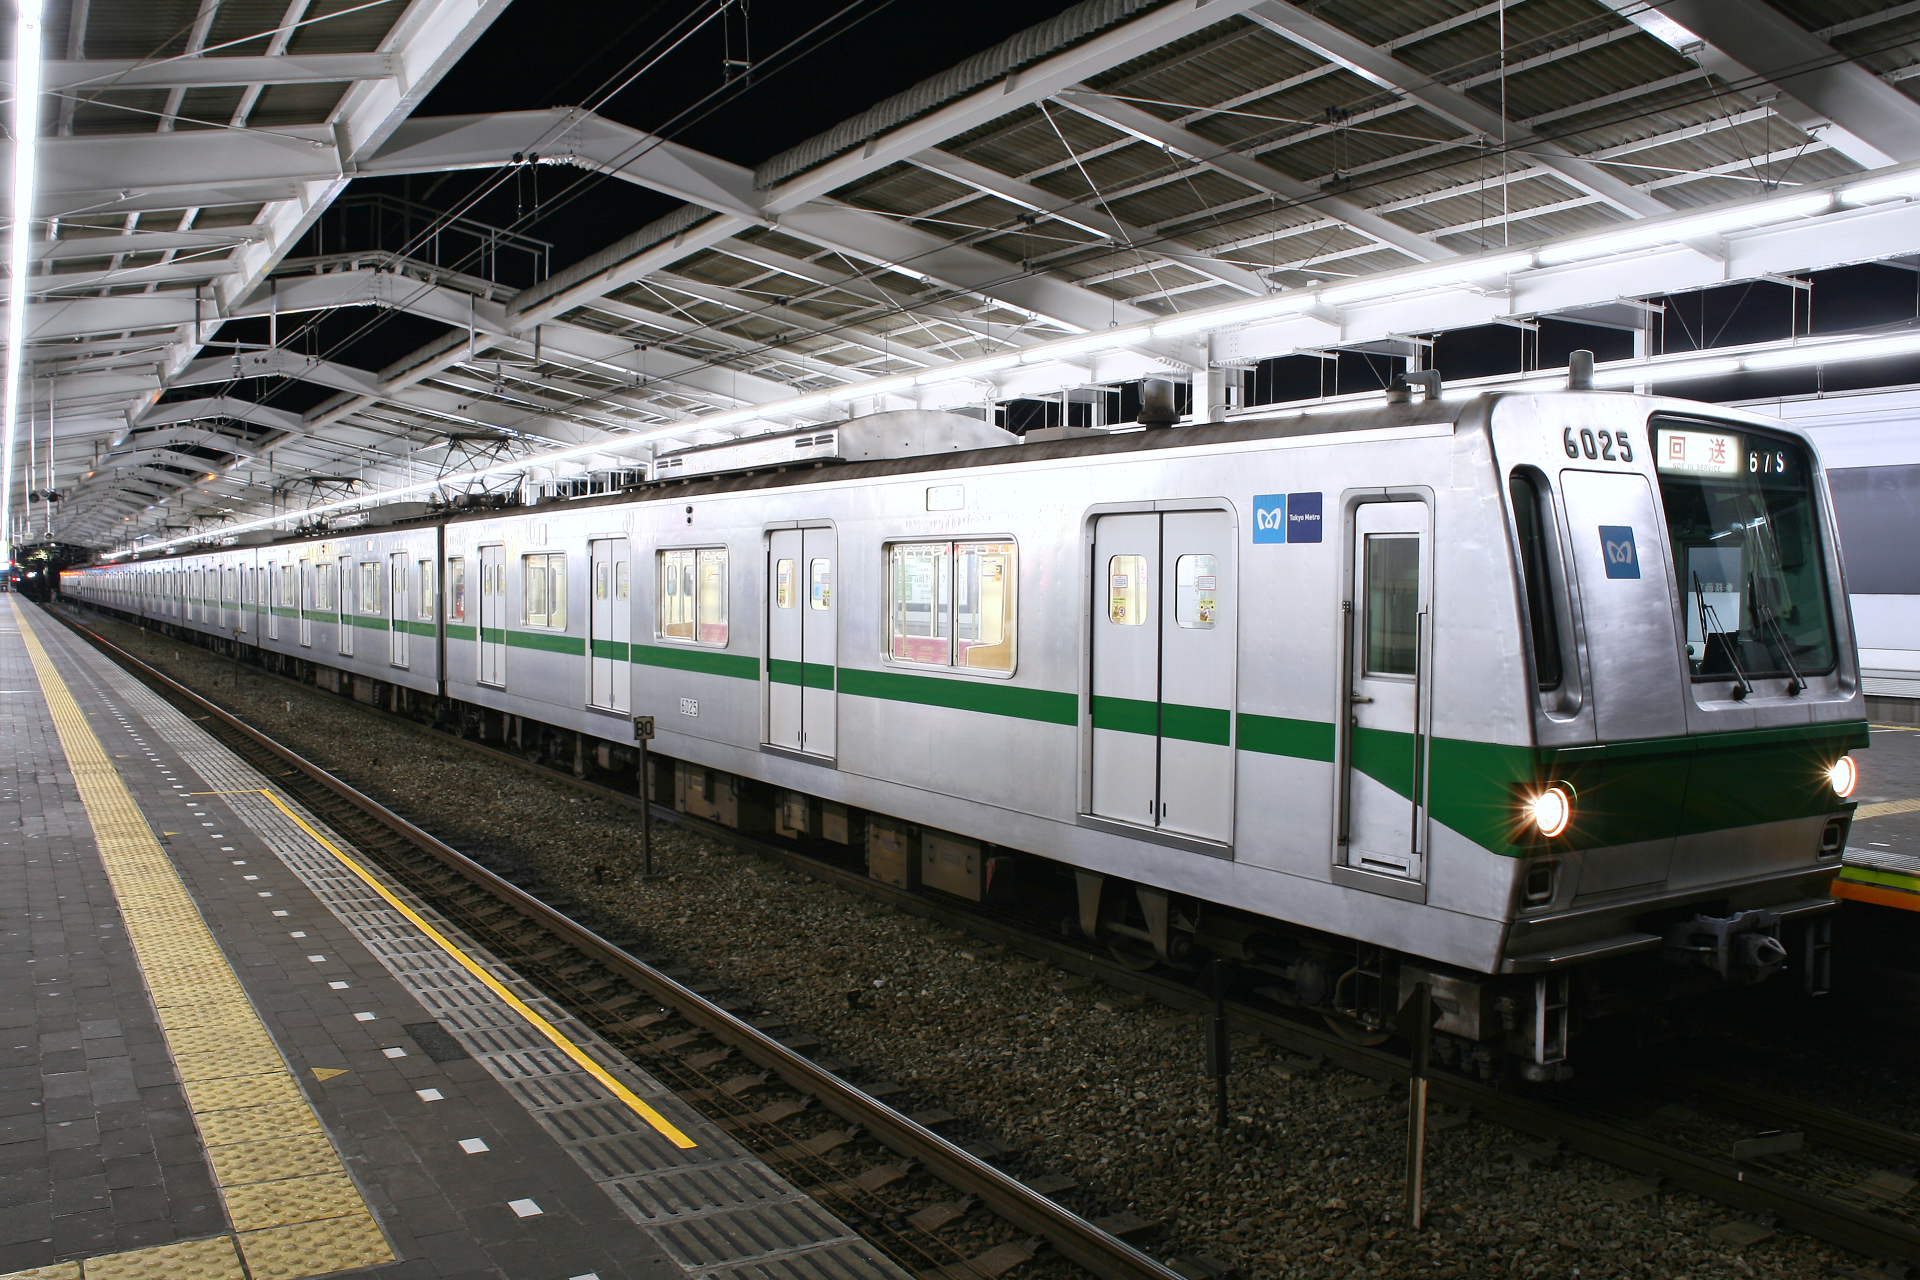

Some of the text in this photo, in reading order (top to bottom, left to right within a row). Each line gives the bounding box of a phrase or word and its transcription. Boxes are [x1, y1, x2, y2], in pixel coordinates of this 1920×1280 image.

[1563, 427, 1633, 463] 6025
[1668, 435, 1726, 464] 回送
[1672, 462, 1721, 473] NOT IN SERVICE
[1289, 513, 1321, 522] Tokyo Metro
